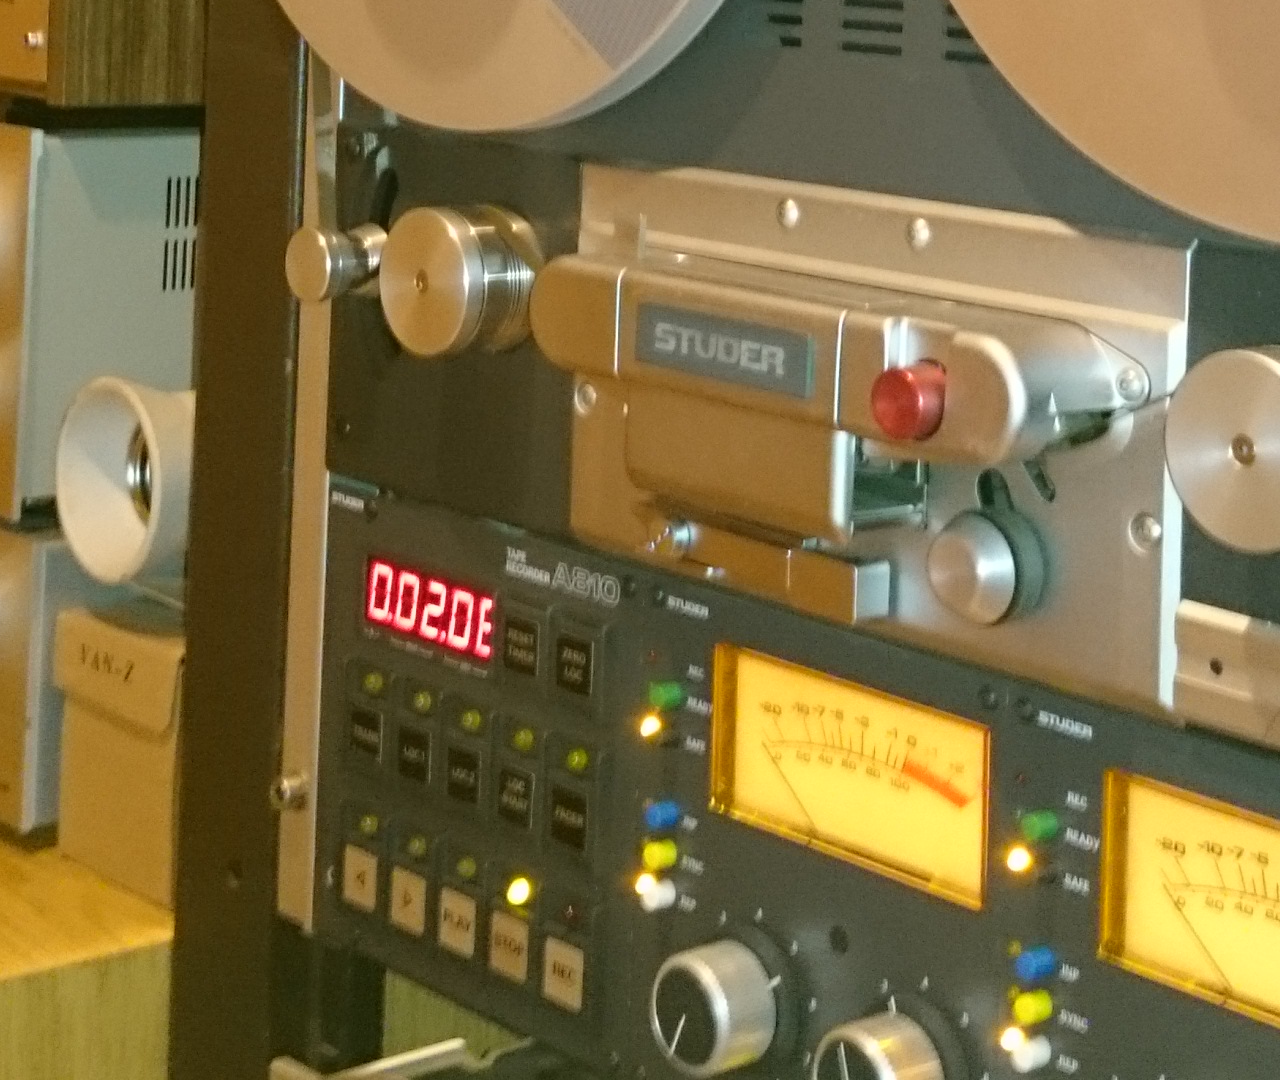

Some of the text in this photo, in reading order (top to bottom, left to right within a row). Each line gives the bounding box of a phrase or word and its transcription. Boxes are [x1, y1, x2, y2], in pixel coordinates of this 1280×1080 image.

[654, 322, 786, 377] STUDER
[506, 561, 551, 586] RECORDER
[550, 561, 621, 609] A810
[668, 595, 710, 620] STUDER
[561, 648, 587, 668] ZERO
[687, 696, 712, 715] READY
[1037, 710, 1093, 741] STUDER
[686, 735, 707, 756] SAFE
[1065, 790, 1088, 812] REC
[1065, 827, 1100, 853] READY
[1156, 838, 1186, 856] -20
[1198, 840, 1223, 857] -10
[1228, 846, 1244, 859] -7
[1063, 872, 1091, 897] SAFE
[1205, 897, 1225, 912] 20
[1234, 901, 1254, 916] 40
